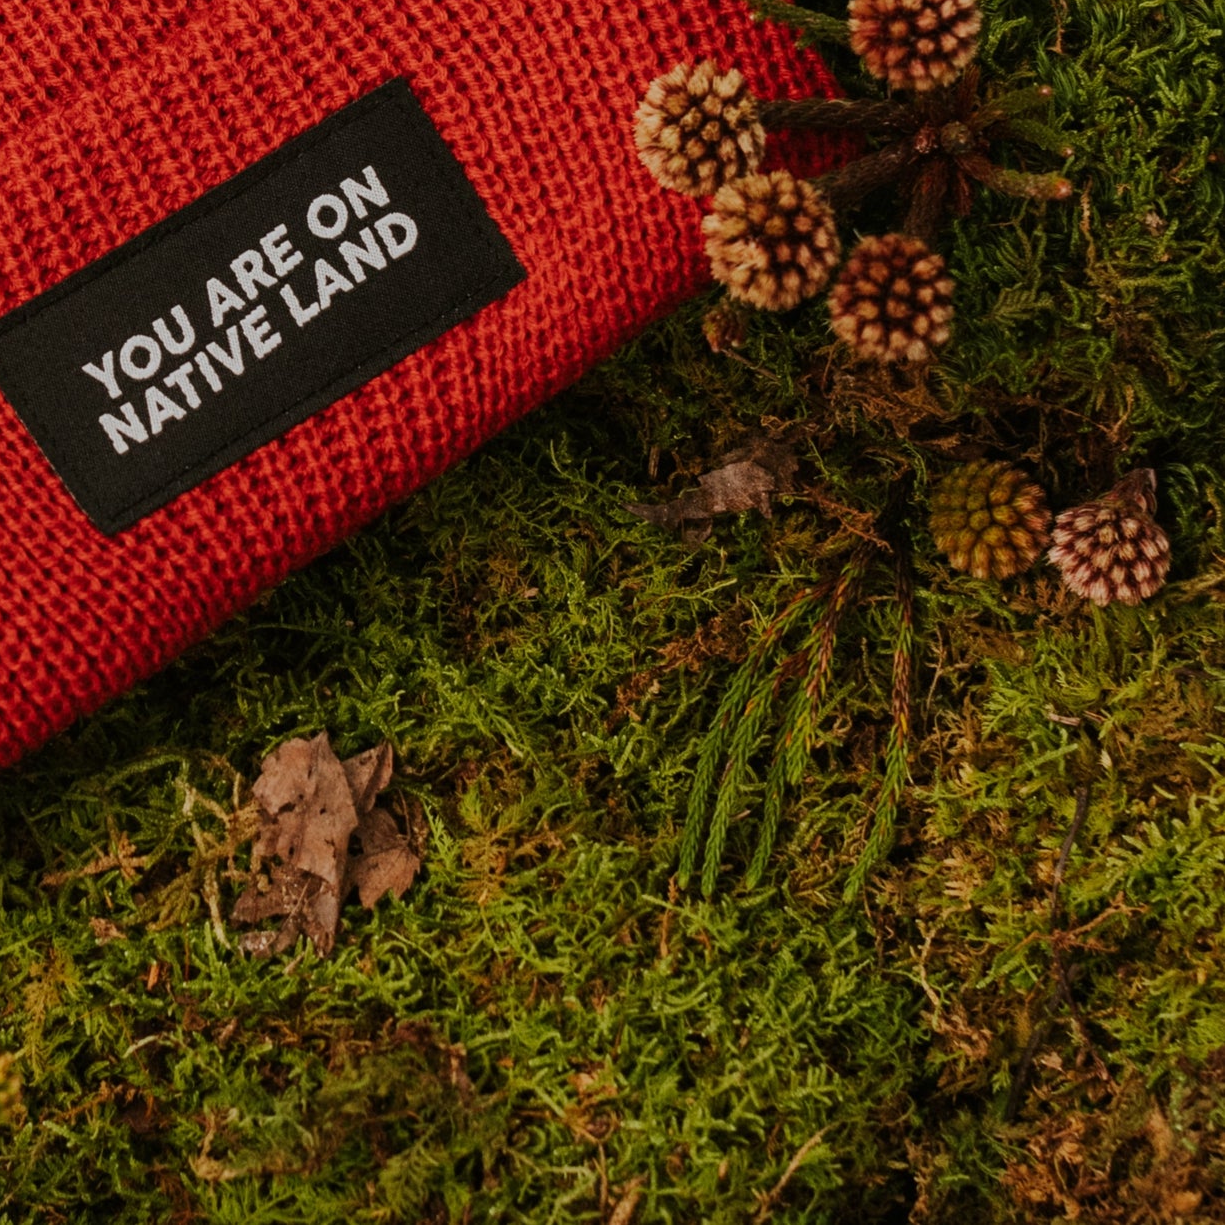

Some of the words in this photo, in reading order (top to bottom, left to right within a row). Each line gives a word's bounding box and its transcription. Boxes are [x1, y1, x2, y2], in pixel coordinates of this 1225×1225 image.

[81, 304, 196, 400] YOU
[206, 223, 304, 328] ARE
[306, 165, 390, 240] ON
[98, 304, 282, 455] NATIVE
[279, 212, 418, 327] LAND
